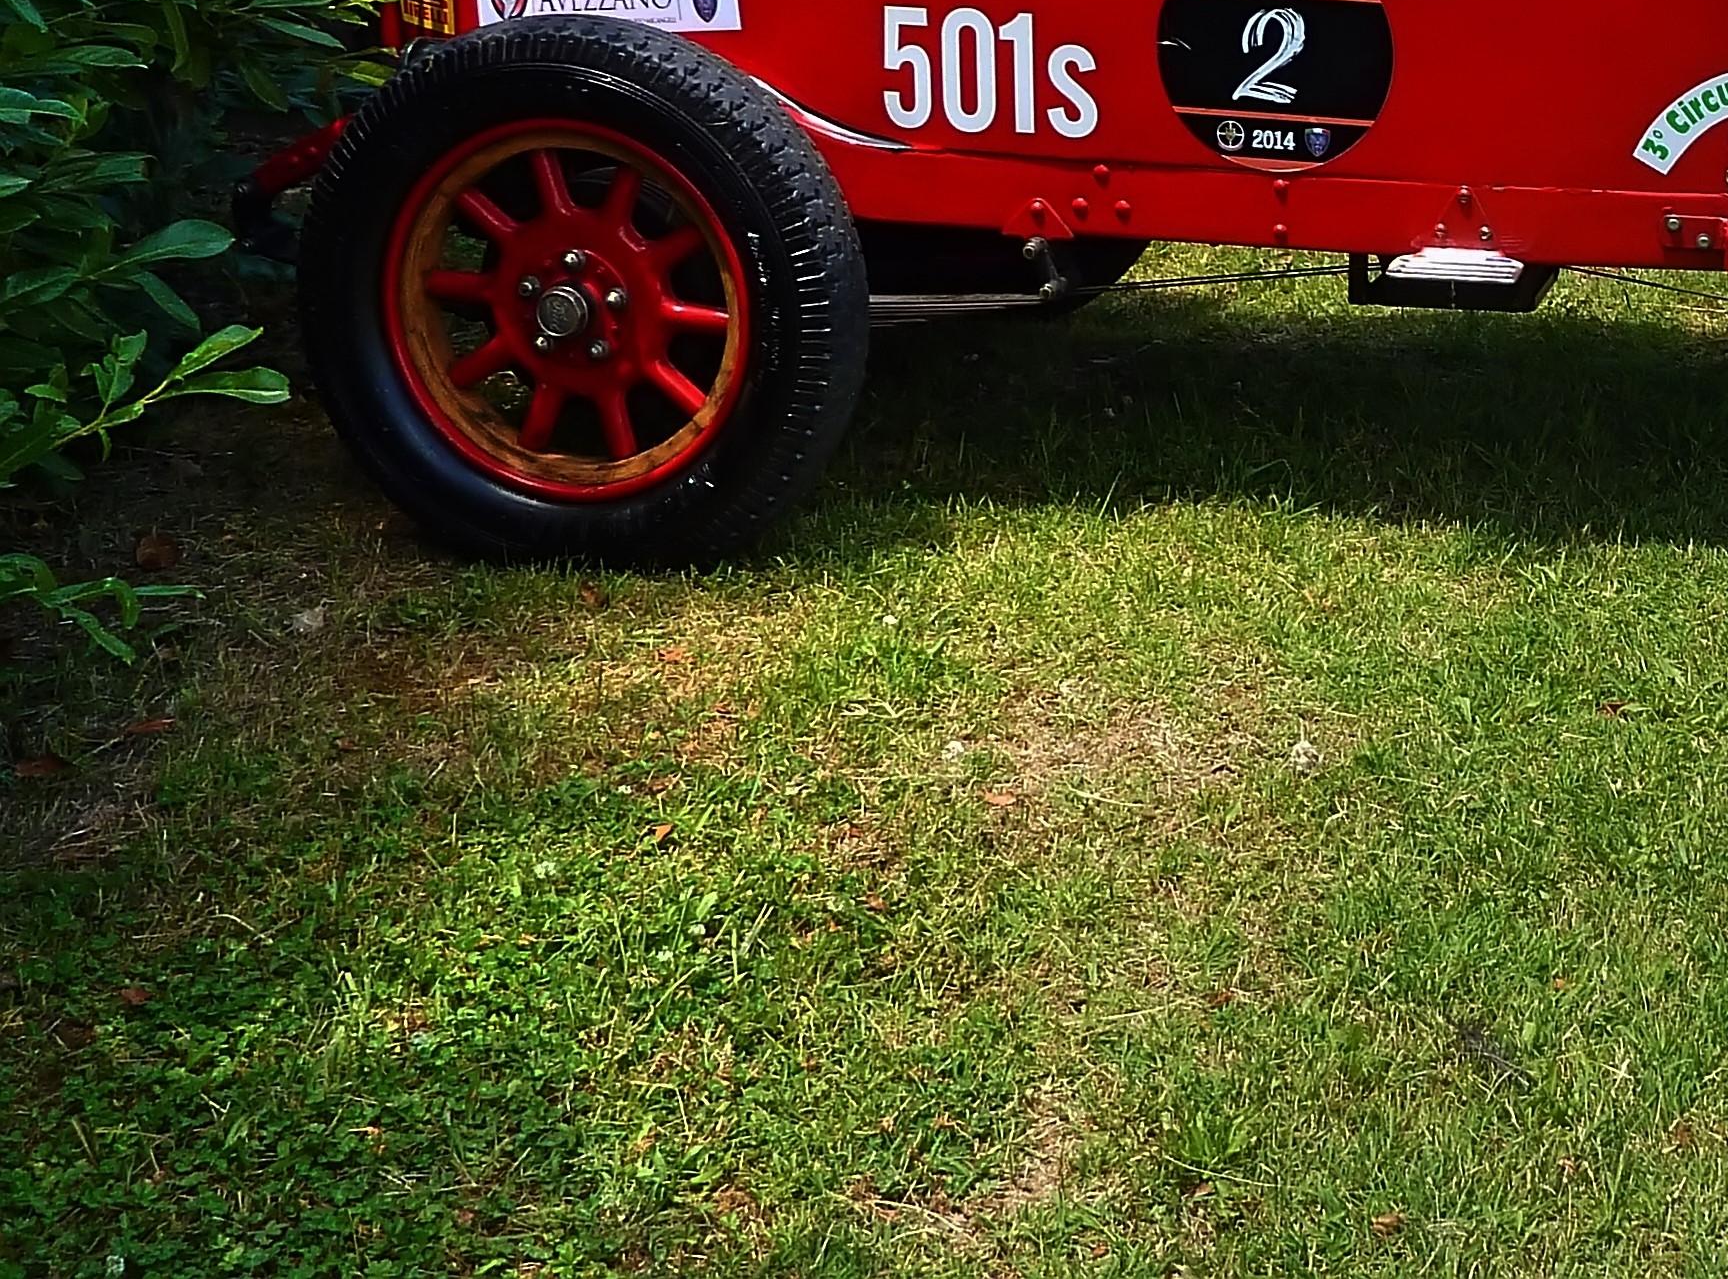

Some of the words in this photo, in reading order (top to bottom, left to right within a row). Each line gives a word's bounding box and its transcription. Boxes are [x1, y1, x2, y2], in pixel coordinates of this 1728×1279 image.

[884, 6, 1098, 138] 501s
[1232, 7, 1306, 104] 2
[1251, 129, 1297, 151] 2014
